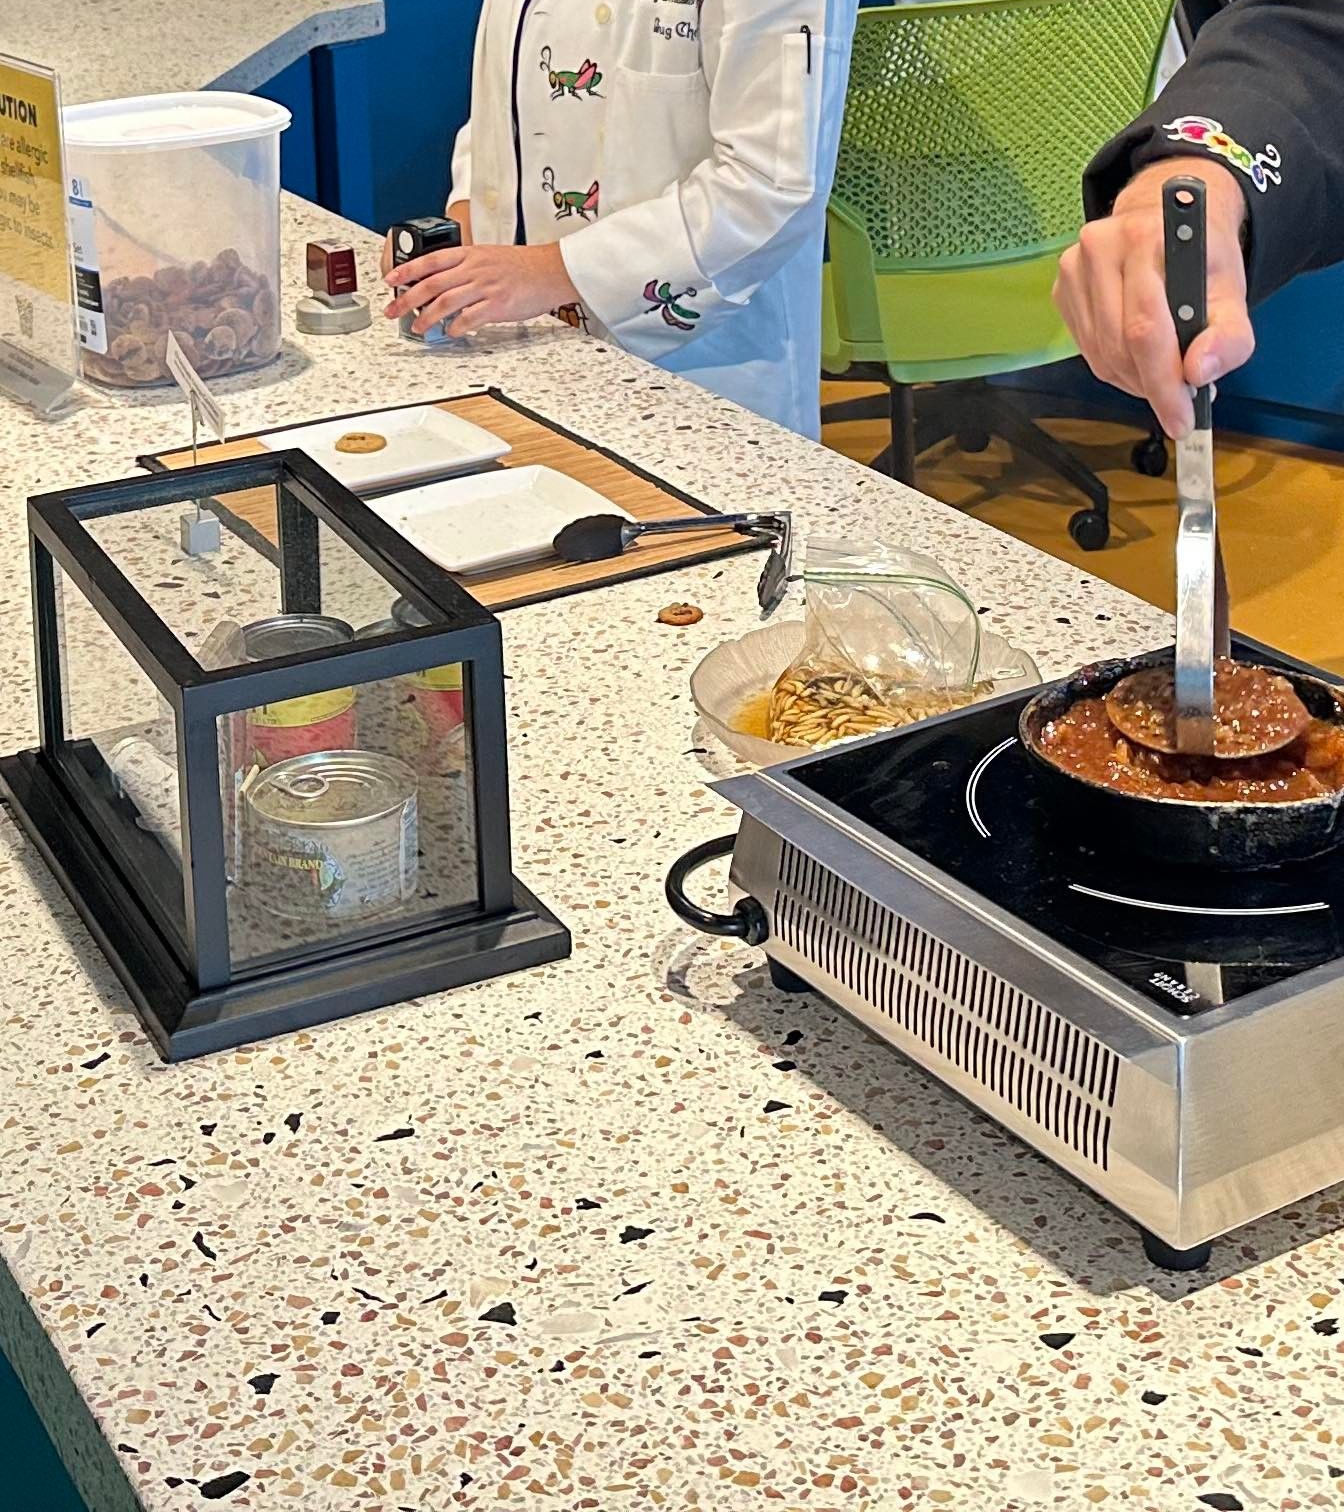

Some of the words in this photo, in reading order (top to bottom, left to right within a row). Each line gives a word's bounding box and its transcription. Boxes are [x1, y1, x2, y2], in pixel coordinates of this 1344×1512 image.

[0, 135, 15, 151] are
[16, 135, 48, 166] allergic
[8, 190, 27, 216] may
[28, 194, 41, 216] be
[13, 216, 22, 236] to
